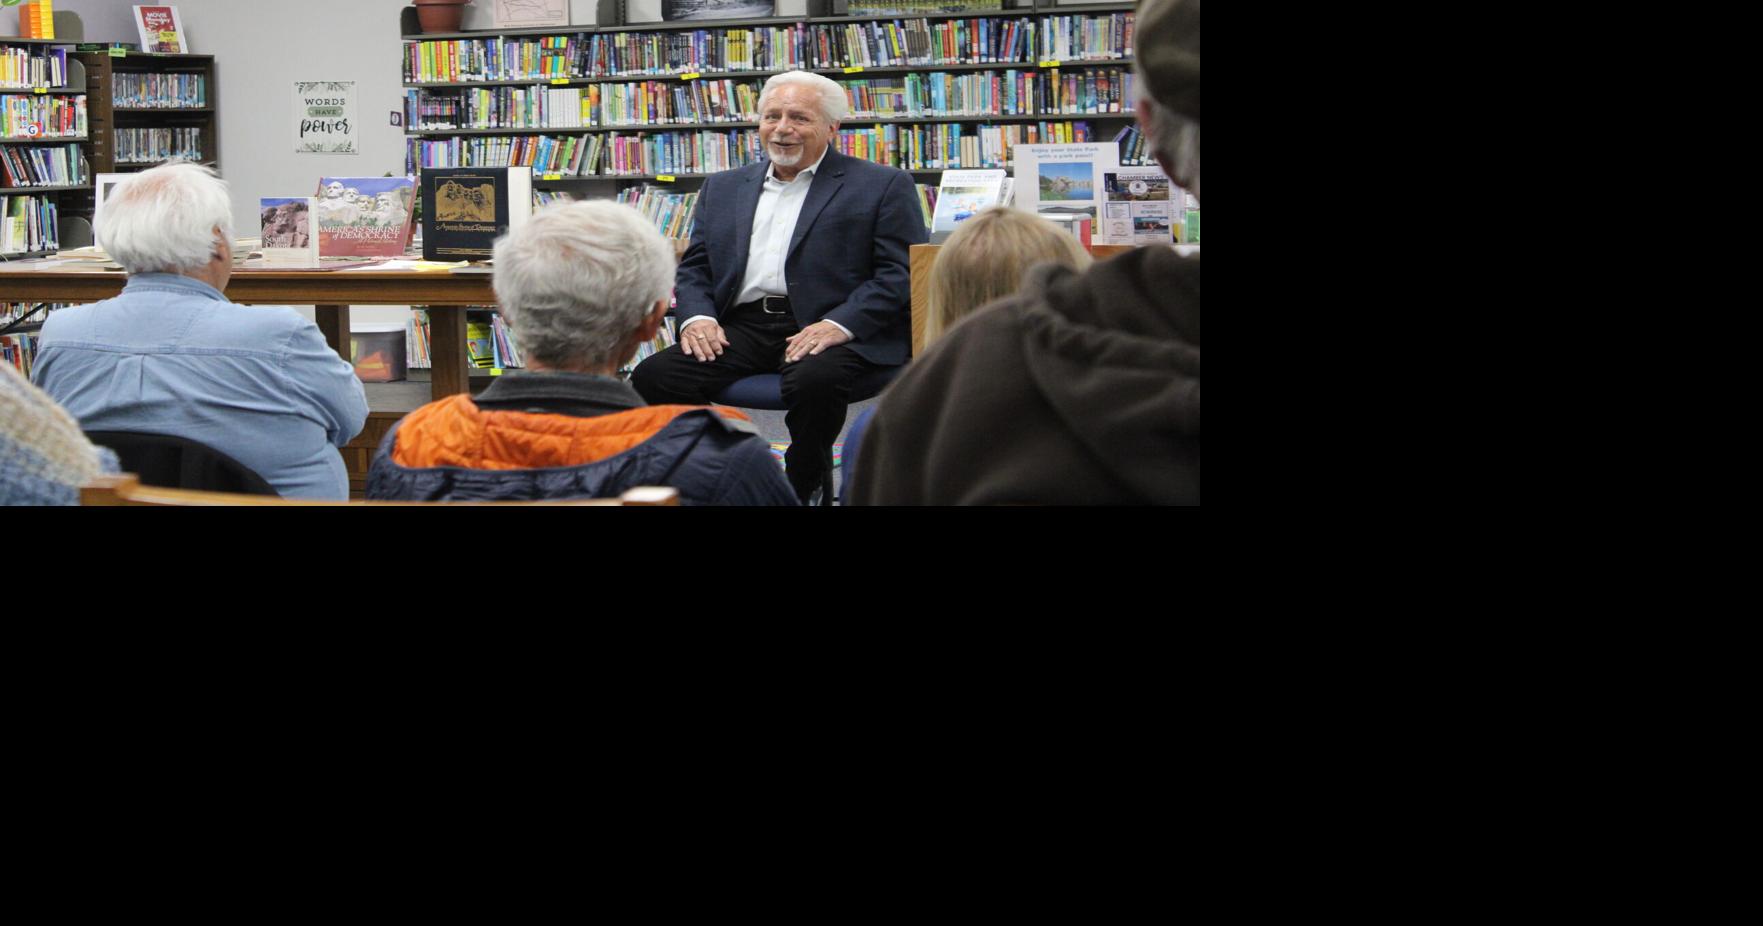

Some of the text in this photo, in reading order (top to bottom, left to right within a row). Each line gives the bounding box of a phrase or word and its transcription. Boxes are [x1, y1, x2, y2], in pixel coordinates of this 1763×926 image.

[305, 98, 346, 106] WORDS
[300, 118, 352, 139] power
[367, 224, 401, 233] SHRINE
[340, 231, 399, 239] DEMOCRACY
